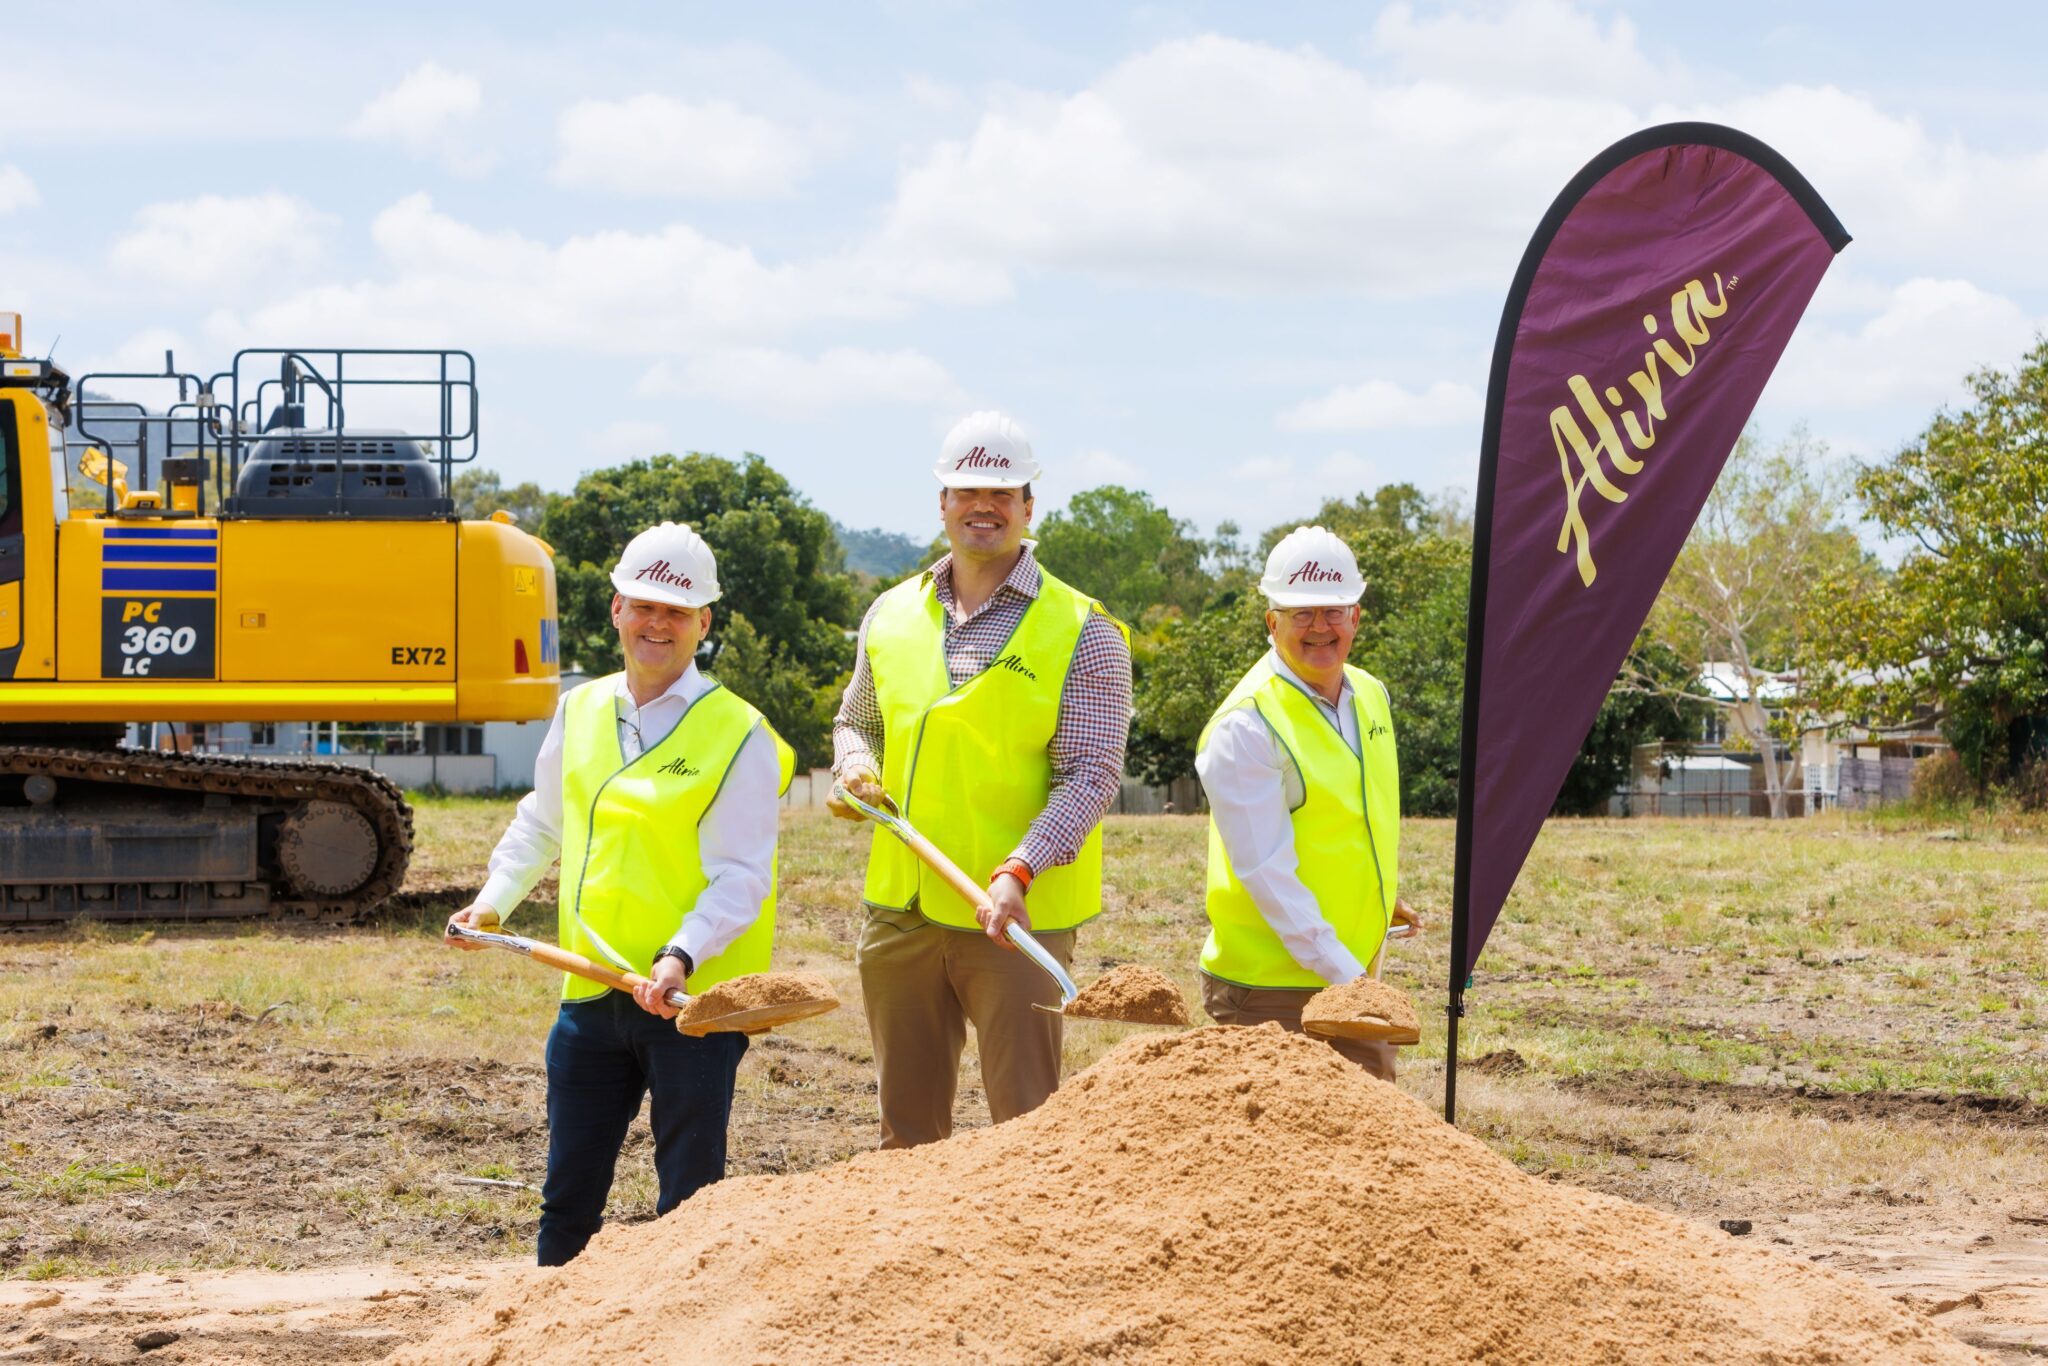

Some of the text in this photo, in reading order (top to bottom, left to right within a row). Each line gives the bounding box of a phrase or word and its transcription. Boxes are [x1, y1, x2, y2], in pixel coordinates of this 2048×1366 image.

[1550, 271, 1739, 588] Aliria TM
[955, 446, 1012, 471] Aliria
[635, 559, 694, 590] Aliria
[1288, 560, 1344, 585] Aliria
[121, 601, 163, 623] PC
[120, 625, 197, 655] 360
[122, 657, 152, 675] LC
[391, 647, 447, 665] EX72
